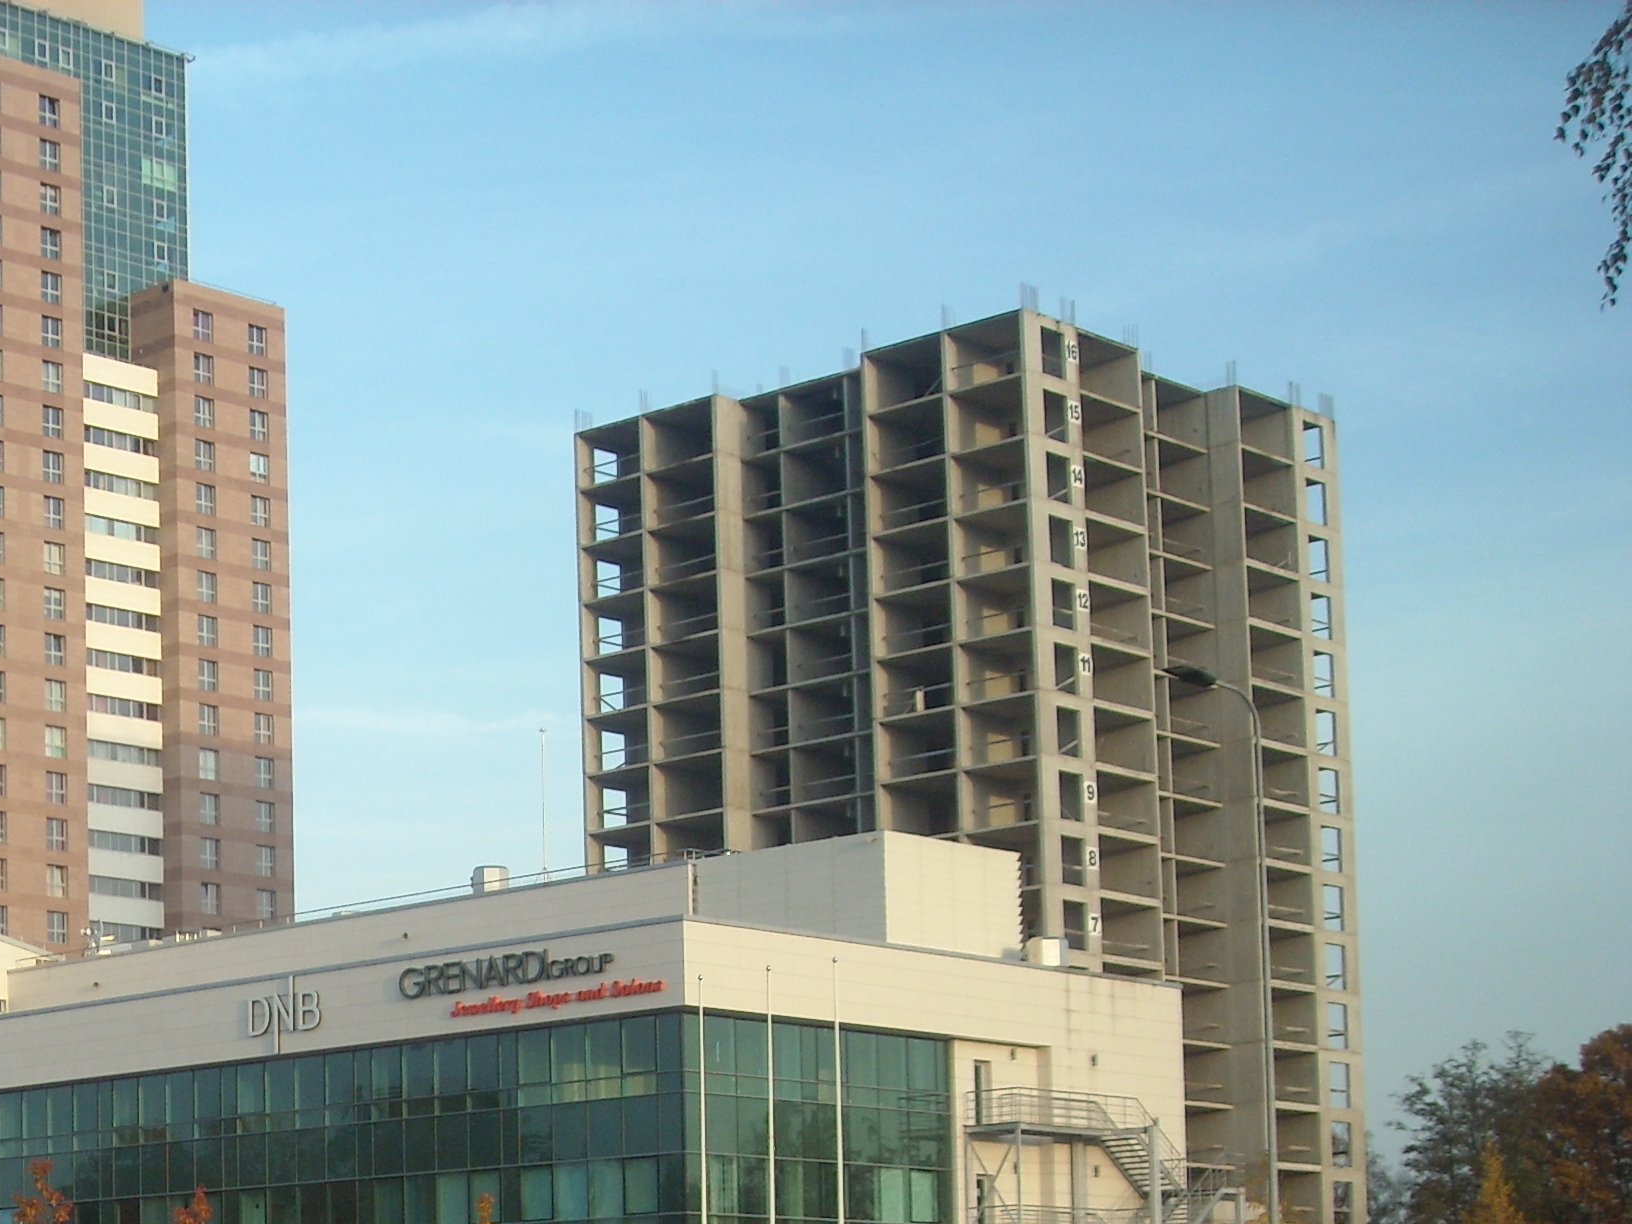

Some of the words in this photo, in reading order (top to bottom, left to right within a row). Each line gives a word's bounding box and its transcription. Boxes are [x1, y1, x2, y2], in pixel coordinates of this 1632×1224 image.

[1066, 340, 1078, 361] 16
[1069, 403, 1080, 421] 15
[1072, 467, 1083, 485] 14
[1073, 530, 1086, 548] 13
[1077, 592, 1089, 610] 12
[1080, 655, 1091, 674] 11
[1086, 784, 1095, 801] 9
[1088, 849, 1097, 867] 8
[1090, 916, 1099, 933] 7
[548, 952, 615, 980] GROUP
[576, 981, 609, 1002] and
[247, 975, 322, 1055] DNB
